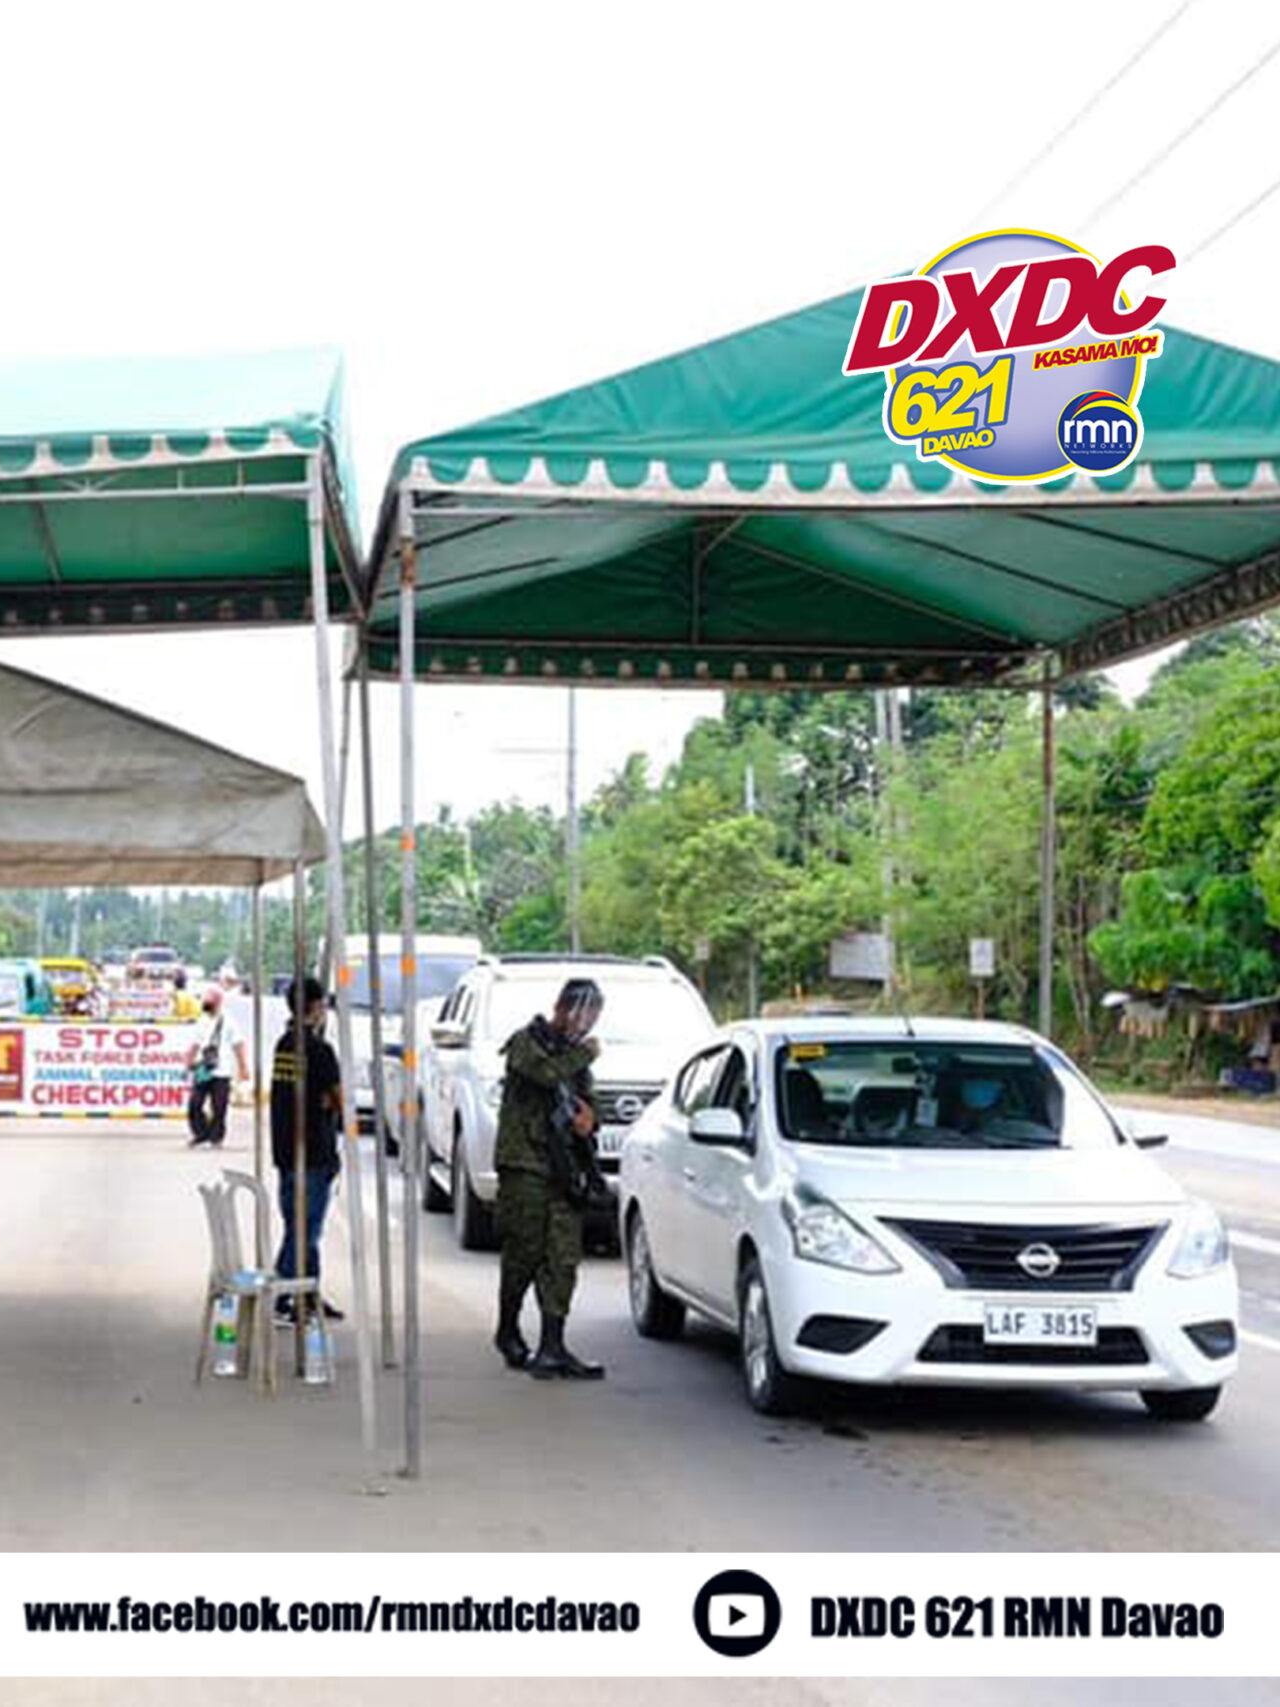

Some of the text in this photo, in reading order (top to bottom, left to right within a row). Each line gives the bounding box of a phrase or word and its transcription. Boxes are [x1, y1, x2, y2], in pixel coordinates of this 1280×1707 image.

[58, 1028, 164, 1048] STOP
[34, 1051, 75, 1063] TASK
[81, 1051, 134, 1064] FORCE
[987, 1312, 1093, 1336] LAF 3815
